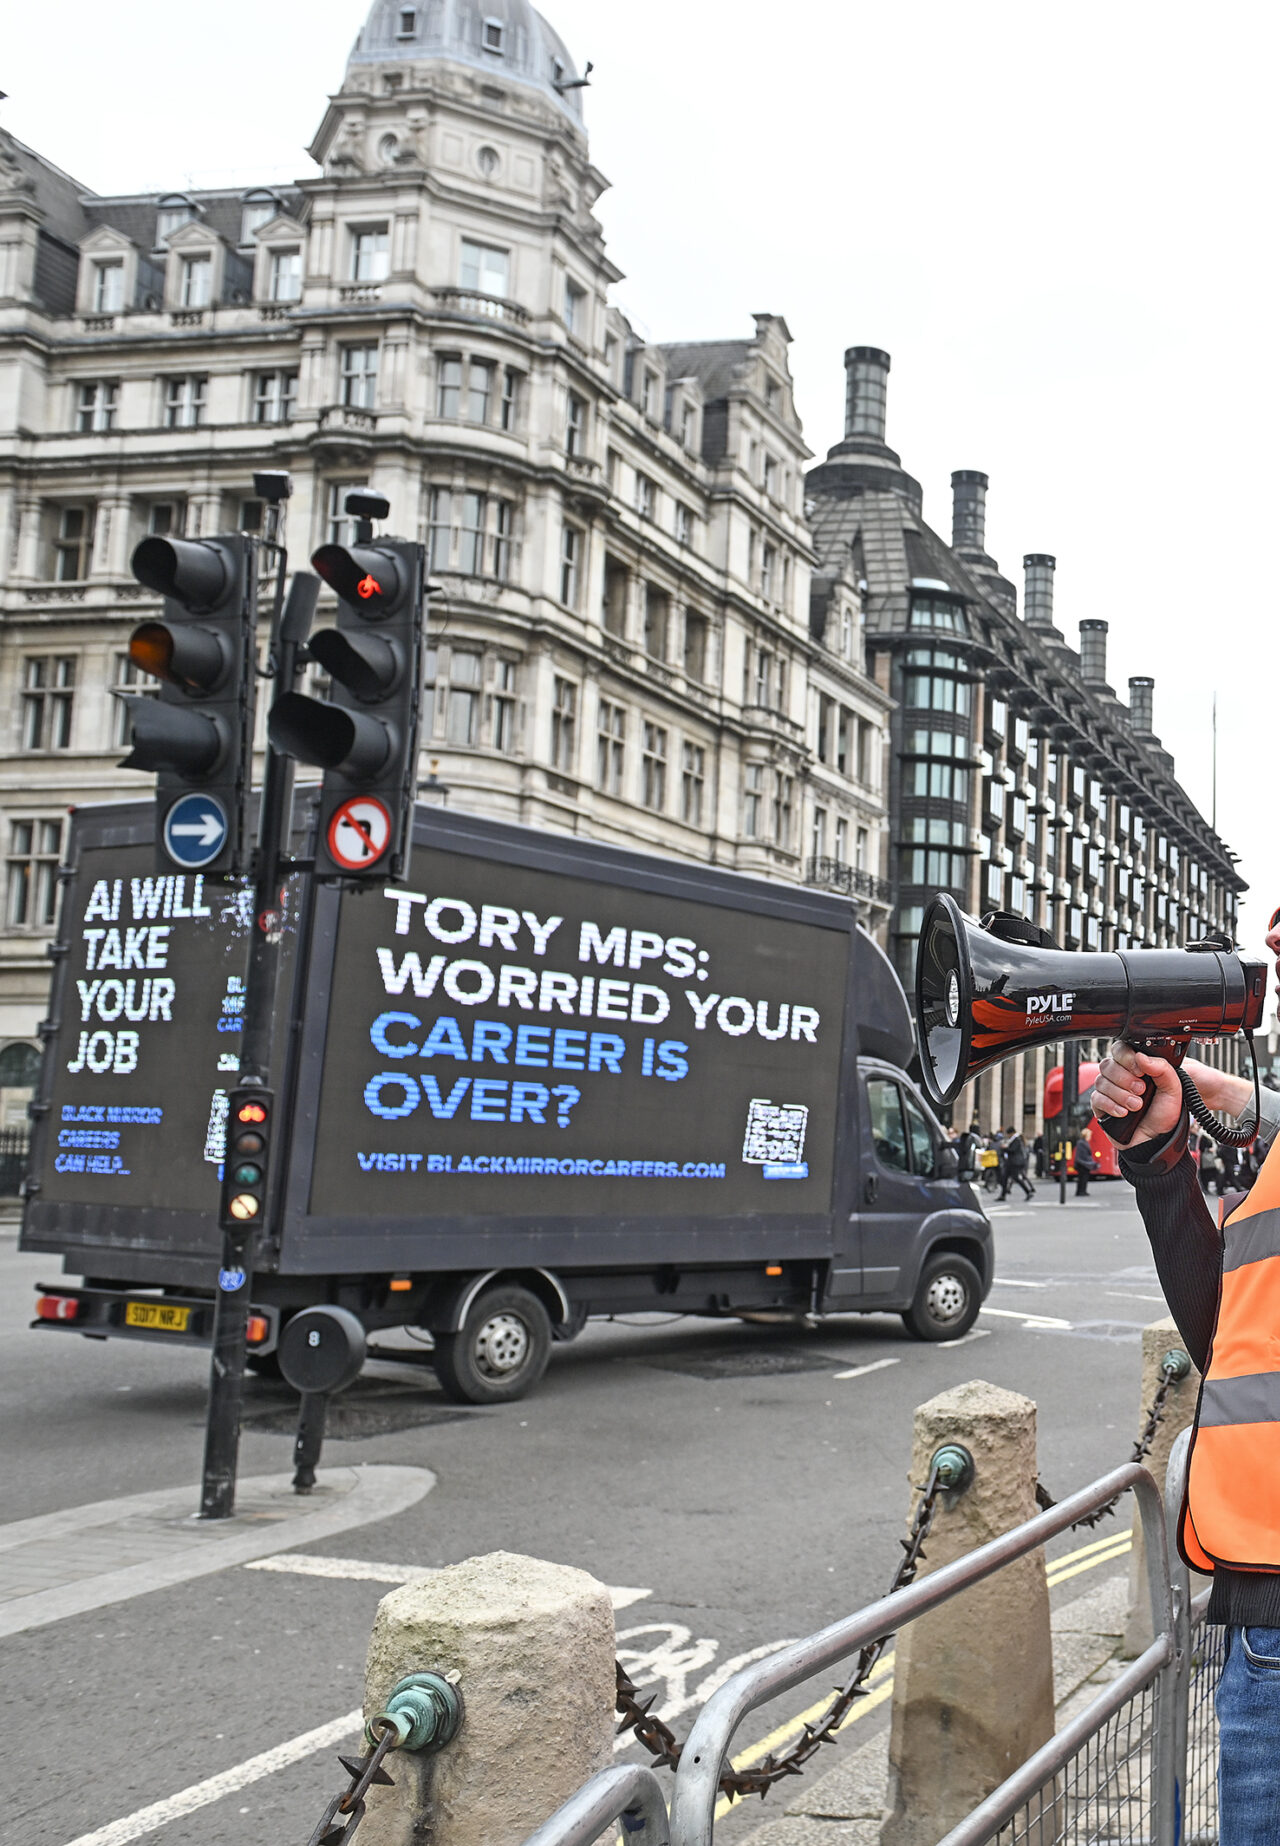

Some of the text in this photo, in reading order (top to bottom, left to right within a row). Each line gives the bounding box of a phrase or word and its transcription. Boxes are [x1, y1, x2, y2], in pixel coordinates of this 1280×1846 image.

[84, 874, 211, 922] AI WILL
[82, 926, 171, 970] TAKE
[383, 888, 710, 981] TORY MPS:
[76, 977, 176, 1022] YOUR
[376, 947, 820, 1042] WORRIED YOUR
[1026, 993, 1074, 1015] PYLE
[1025, 1014, 1072, 1027] PyleUSA.com
[67, 1030, 139, 1074] JOB
[369, 1011, 690, 1081] CAREER IS
[61, 1105, 106, 1122] BLACK
[363, 1071, 582, 1128] OVER?
[357, 1152, 726, 1178] VISIT BLACKMIRRORCAREERS.COM
